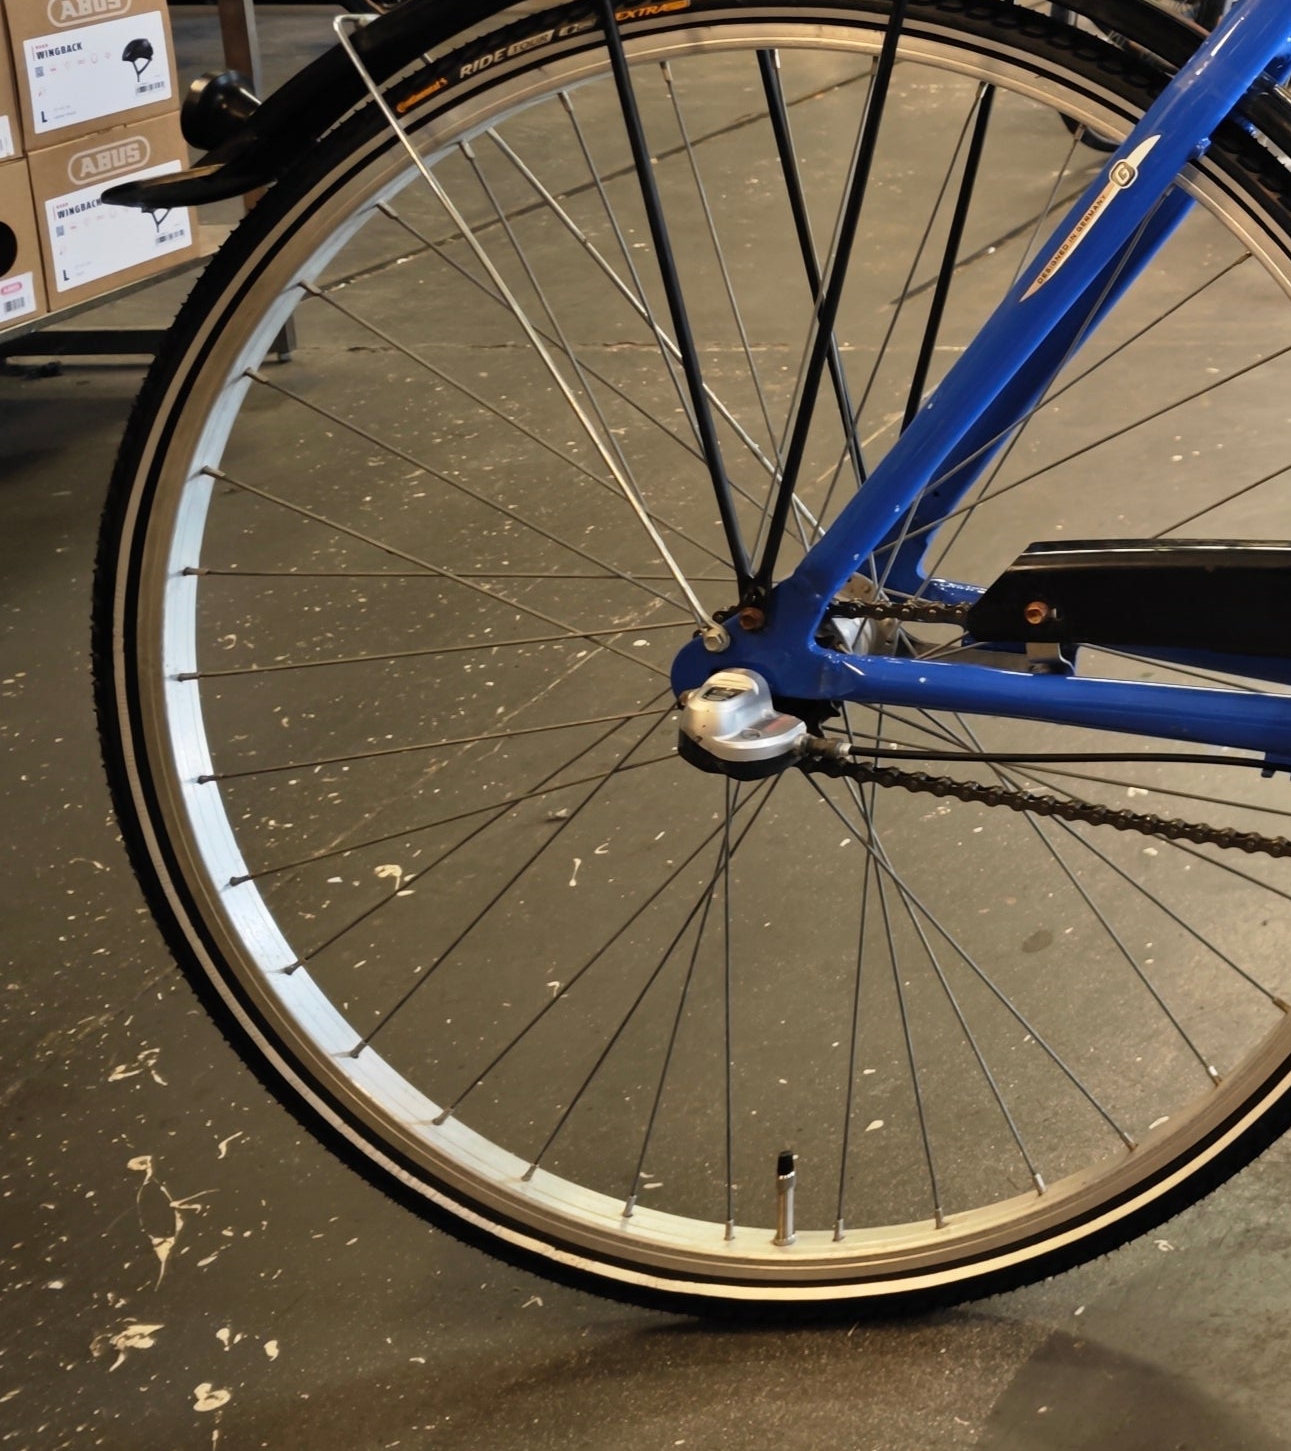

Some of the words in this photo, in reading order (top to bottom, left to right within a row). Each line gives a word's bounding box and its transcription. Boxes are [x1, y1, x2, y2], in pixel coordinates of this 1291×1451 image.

[36, 42, 83, 60] WINGBACK
[459, 47, 507, 80] RIDE
[615, 2, 664, 22] EXTRA
[41, 111, 48, 123] L
[80, 144, 141, 178] ABUS
[1036, 242, 1069, 285] DESIGNED
[1068, 233, 1077, 243] IN
[1075, 194, 1107, 234] GERMANY
[63, 269, 70, 281] L
